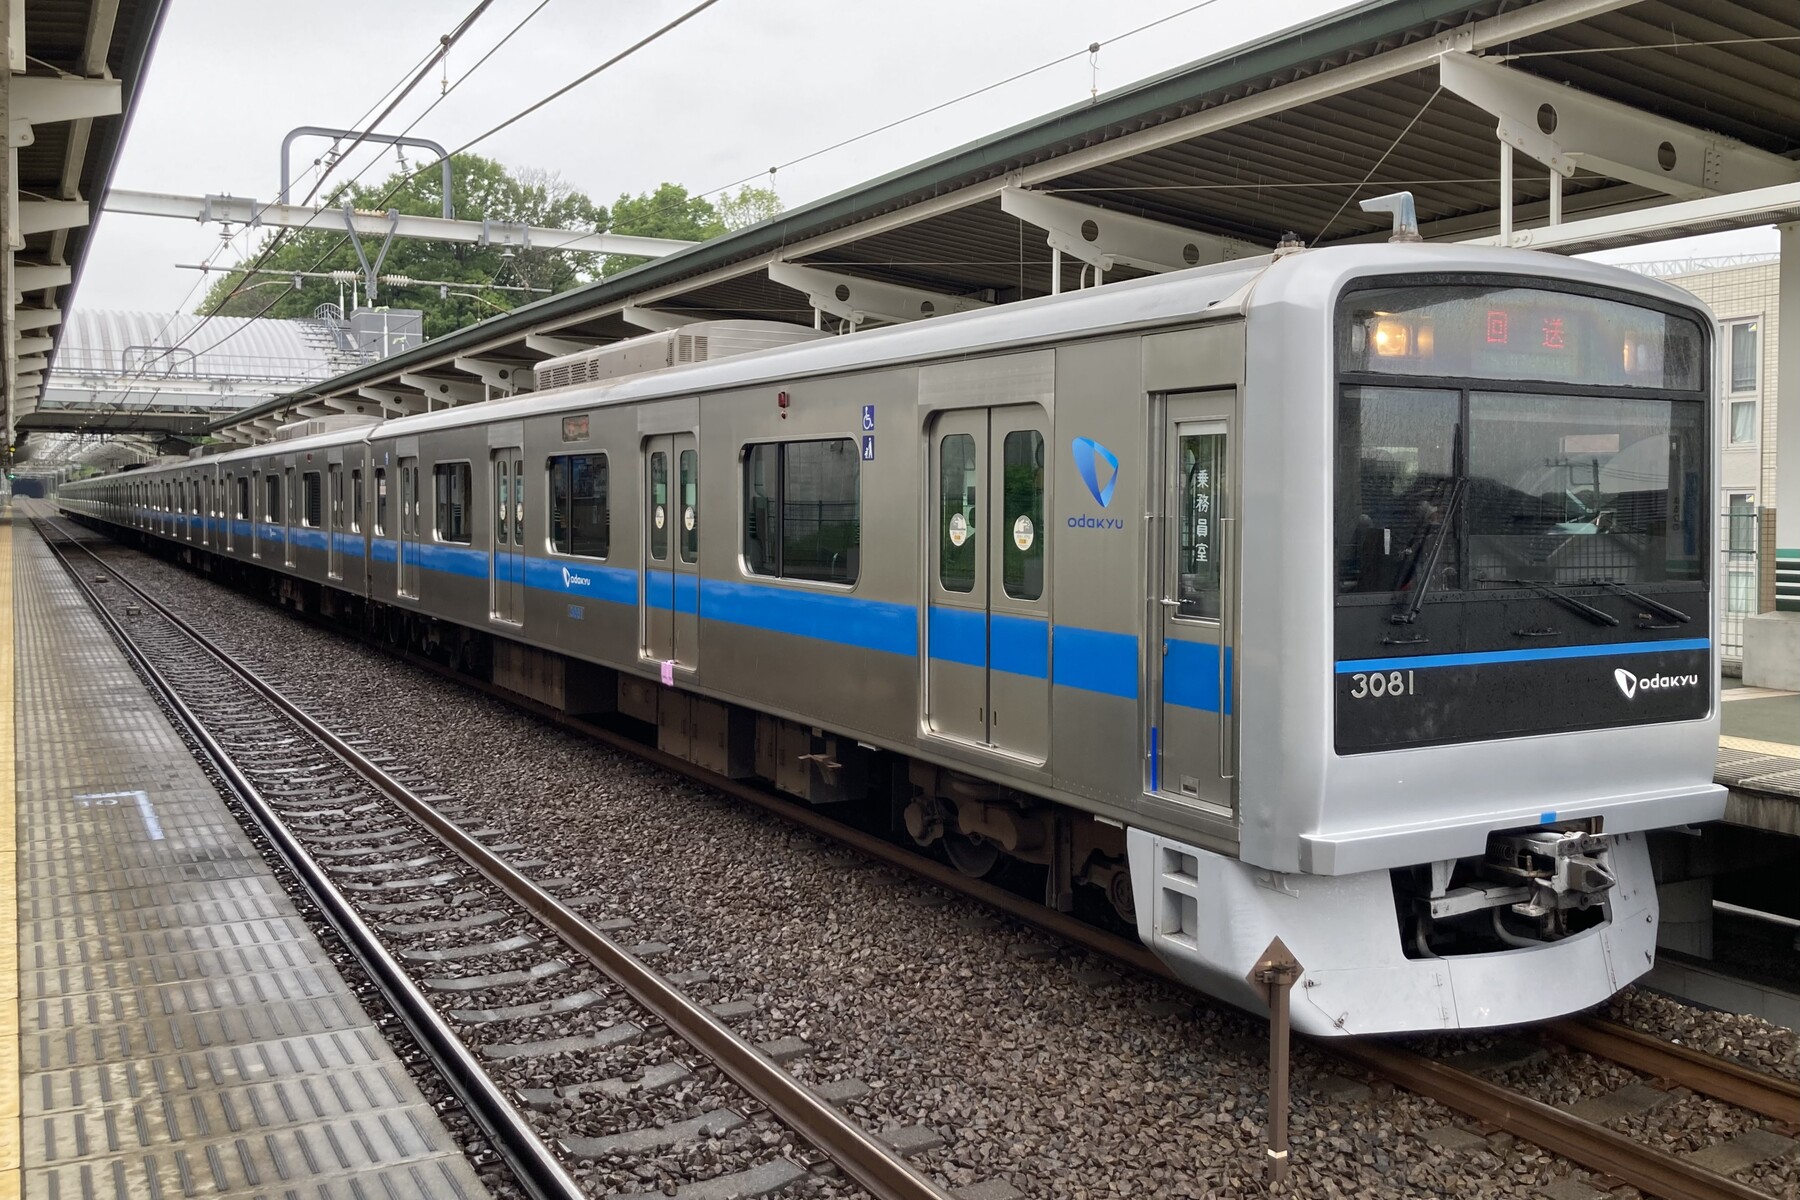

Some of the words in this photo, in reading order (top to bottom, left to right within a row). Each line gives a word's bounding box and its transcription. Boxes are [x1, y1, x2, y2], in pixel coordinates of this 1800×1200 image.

[1486, 310, 1565, 349] 回送
[1067, 513, 1124, 530] odakyu
[1195, 469, 1209, 562] 乗務員室
[570, 573, 591, 586] odakyu
[1350, 670, 1414, 699] 3081
[1639, 673, 1698, 690] odakyu
